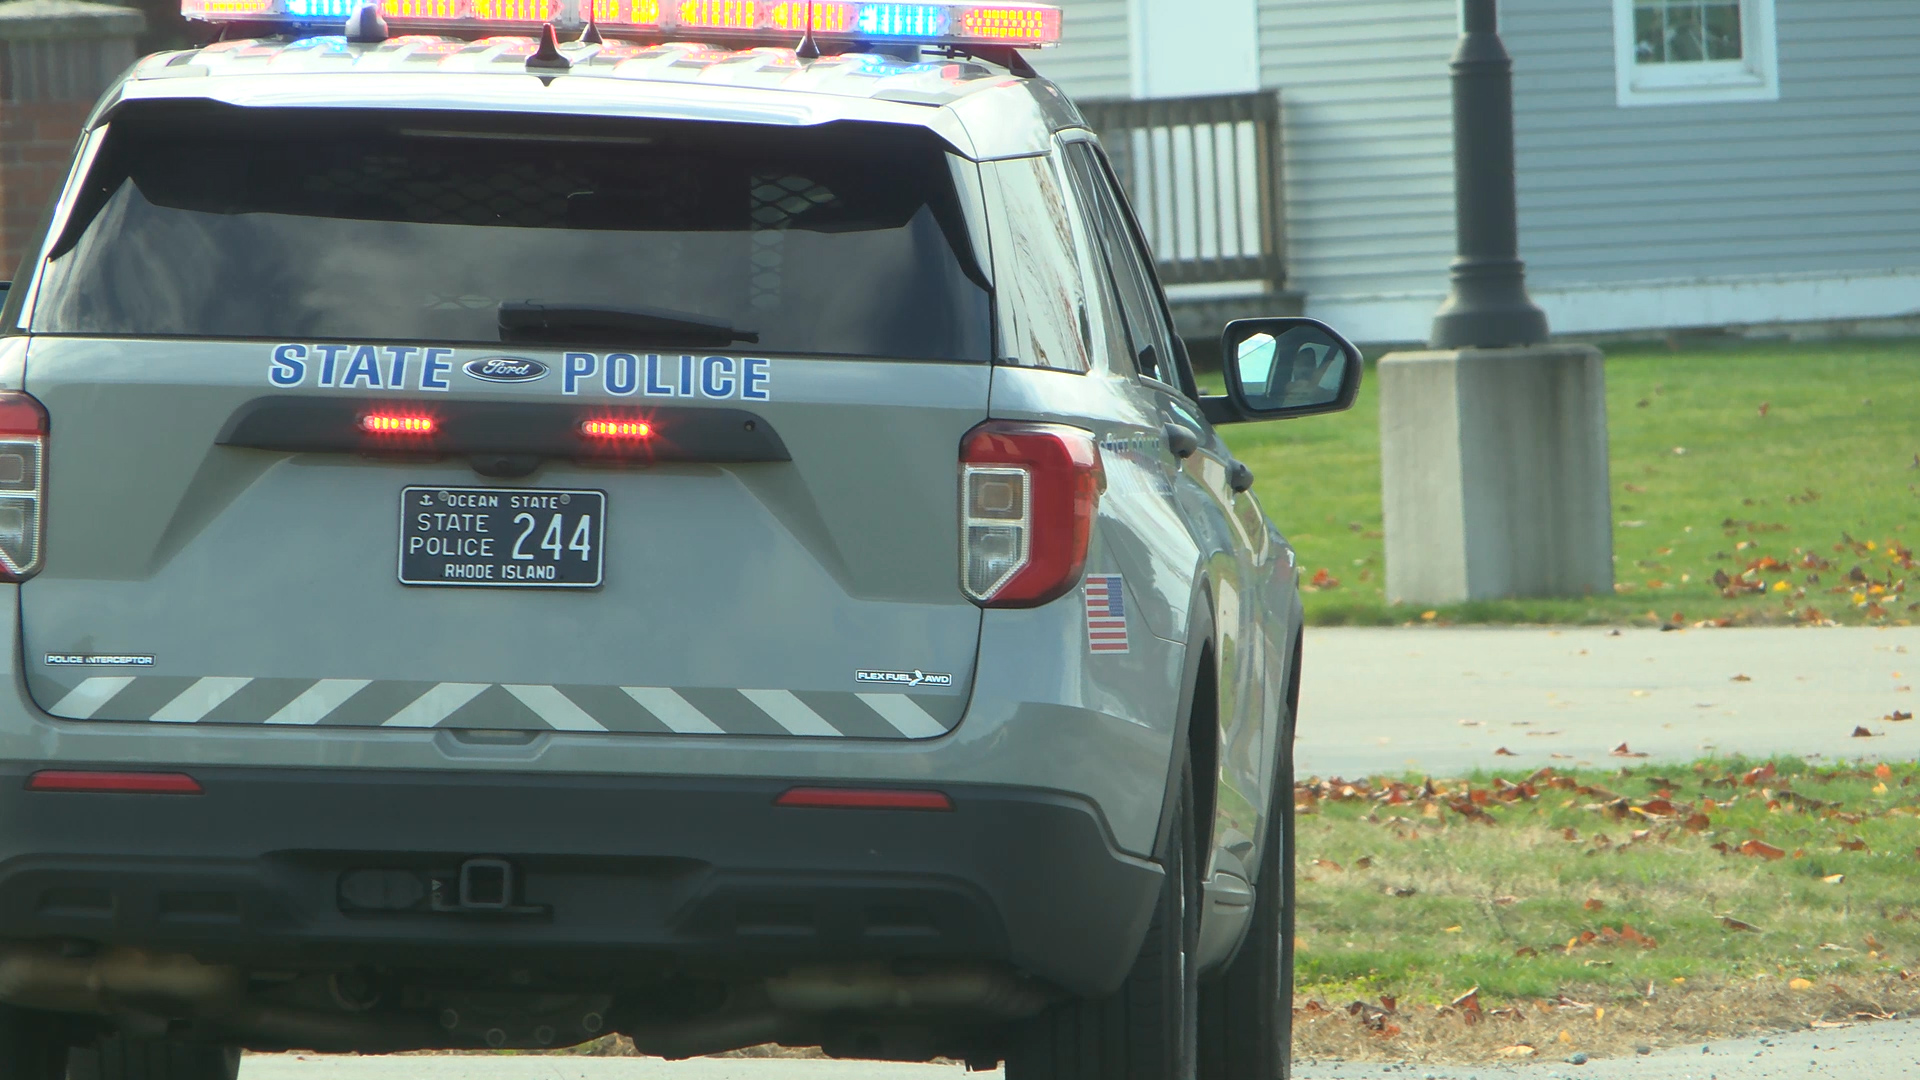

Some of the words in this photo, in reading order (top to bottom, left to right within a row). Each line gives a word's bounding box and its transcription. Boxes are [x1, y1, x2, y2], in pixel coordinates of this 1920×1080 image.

[268, 343, 455, 391] STATE
[562, 351, 770, 401] POLICE
[482, 359, 530, 375] Ford
[447, 494, 498, 508] OCEAN
[511, 496, 559, 509] STATE
[417, 513, 489, 533] STATE
[512, 512, 591, 561] 244
[409, 537, 495, 557] POLICE
[445, 564, 494, 579] RHODE
[502, 565, 556, 580] ISLAND
[47, 655, 83, 664] POLICE
[86, 656, 152, 665] INTERCEPTOR
[858, 672, 885, 680] FLEX
[886, 673, 912, 681] FUEL
[925, 675, 949, 683] AWD
